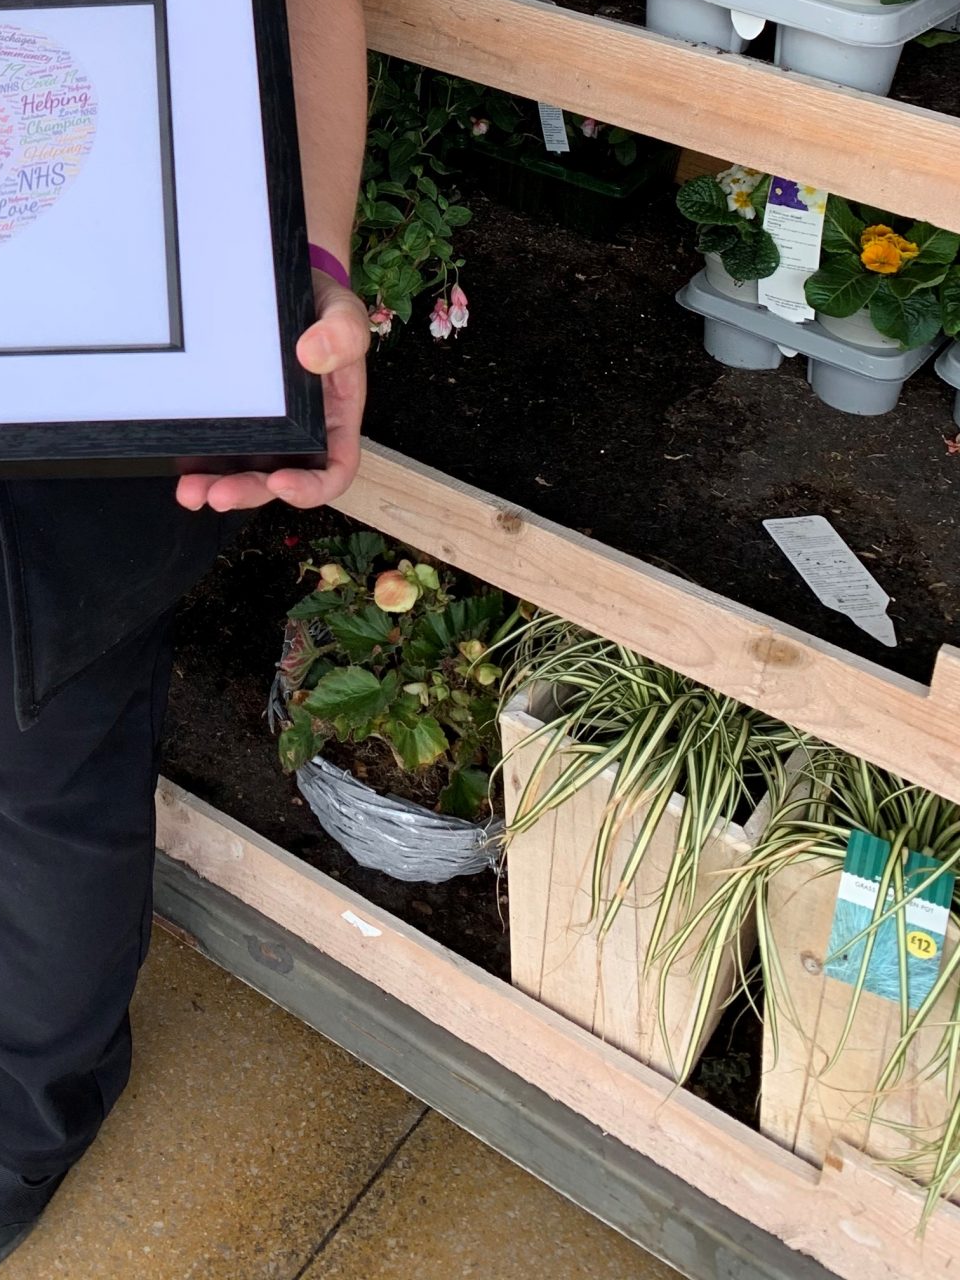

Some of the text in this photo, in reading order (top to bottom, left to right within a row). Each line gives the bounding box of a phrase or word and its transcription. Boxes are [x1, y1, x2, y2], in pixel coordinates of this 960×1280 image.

[0, 82, 20, 94] NHS
[21, 90, 91, 115] Helping
[17, 161, 67, 193] NHS
[854, 880, 876, 894] GRASS
[910, 935, 932, 954] £12
